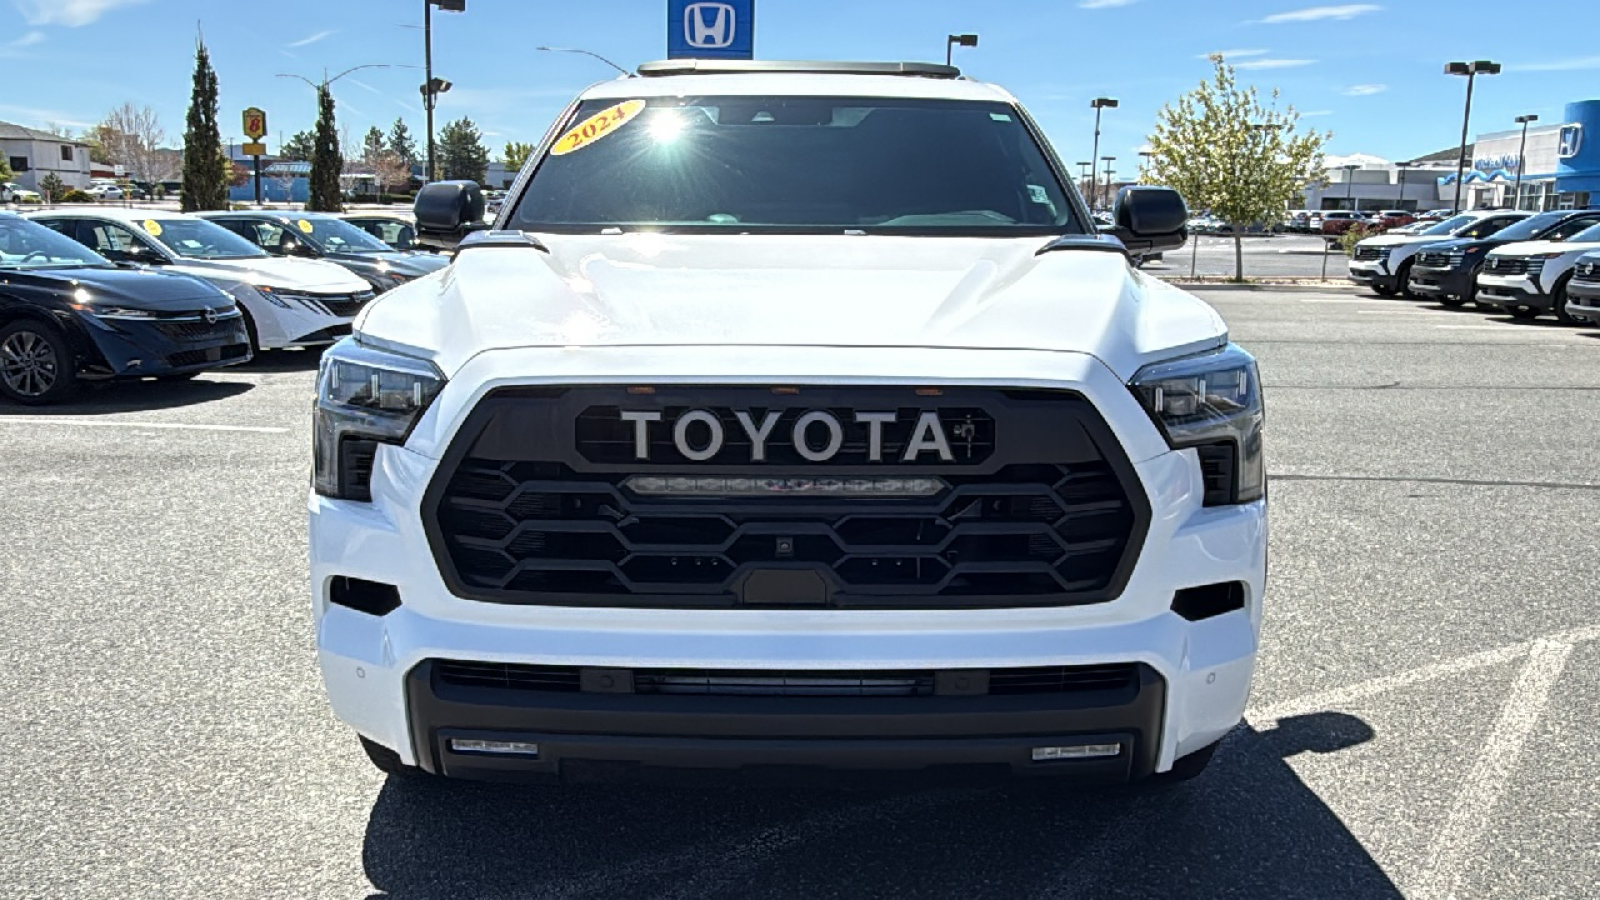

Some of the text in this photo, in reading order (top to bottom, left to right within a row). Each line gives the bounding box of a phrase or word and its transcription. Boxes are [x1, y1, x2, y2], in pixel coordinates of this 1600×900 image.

[249, 118, 261, 132] 8
[567, 106, 625, 148] 2024
[620, 409, 955, 462] TOYOTA
